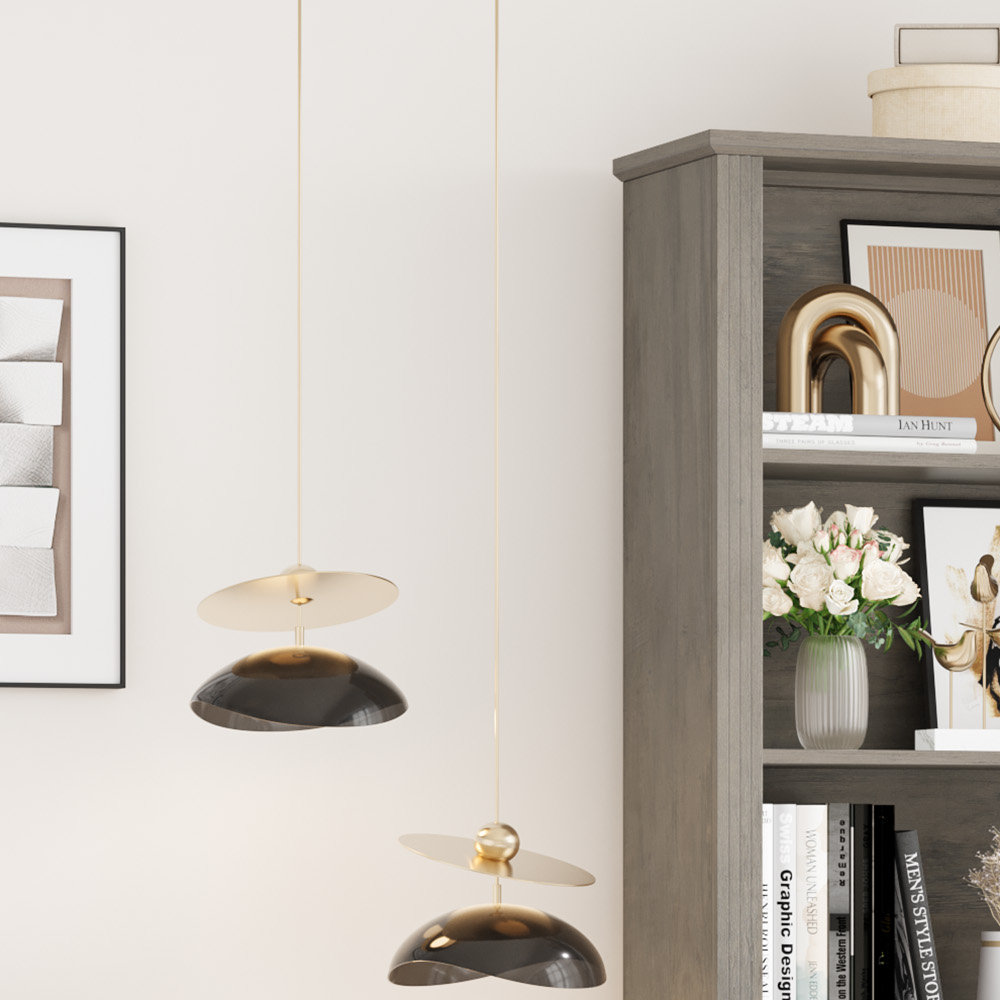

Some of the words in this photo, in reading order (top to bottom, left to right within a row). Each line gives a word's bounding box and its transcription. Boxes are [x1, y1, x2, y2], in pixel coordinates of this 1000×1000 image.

[898, 419, 919, 431] IAN
[921, 420, 953, 432] HUNT
[804, 829, 818, 873] WOMAN
[904, 851, 925, 904] MEN'S
[777, 869, 793, 938] Graphic
[805, 875, 819, 936] UNLEASHED
[912, 906, 933, 959] STYLE
[836, 938, 847, 973] Western
[836, 974, 847, 987] the
[838, 989, 847, 1000] on
